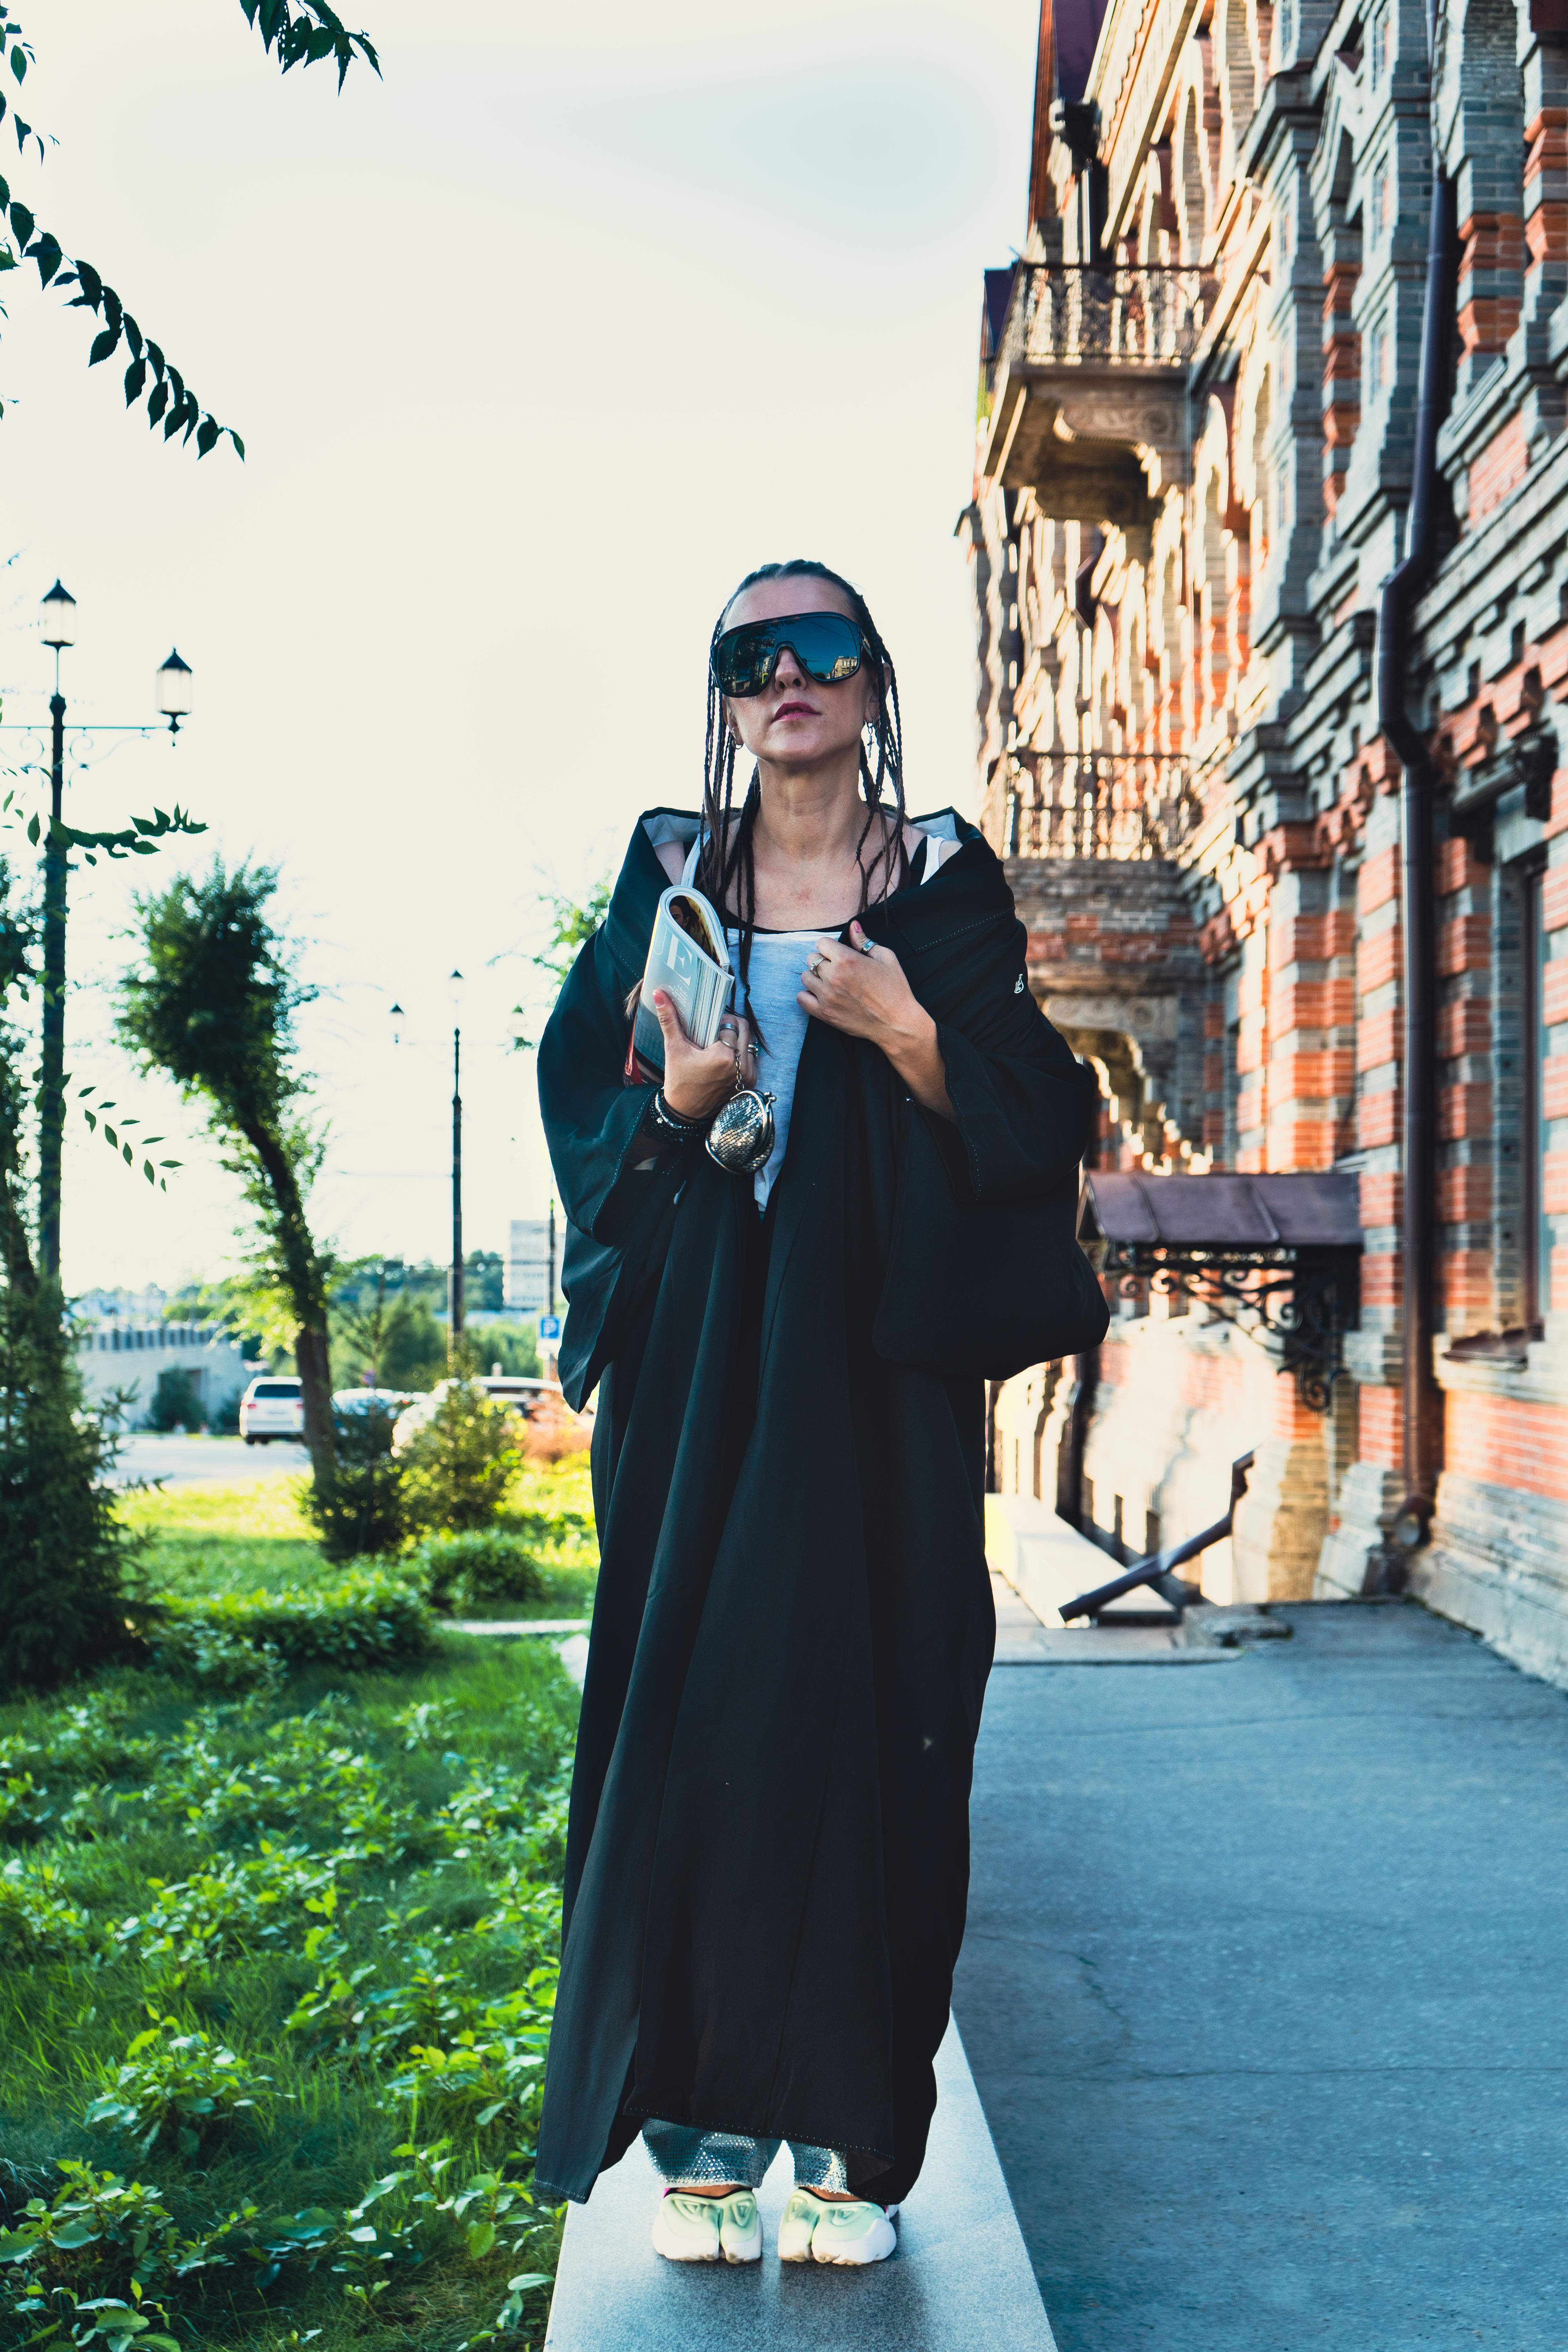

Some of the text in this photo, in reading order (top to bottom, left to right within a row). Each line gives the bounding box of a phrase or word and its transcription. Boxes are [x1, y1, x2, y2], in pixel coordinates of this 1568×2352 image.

[677, 984, 688, 997] Mode
[674, 991, 686, 1004] monde
[678, 997, 686, 1007] style
